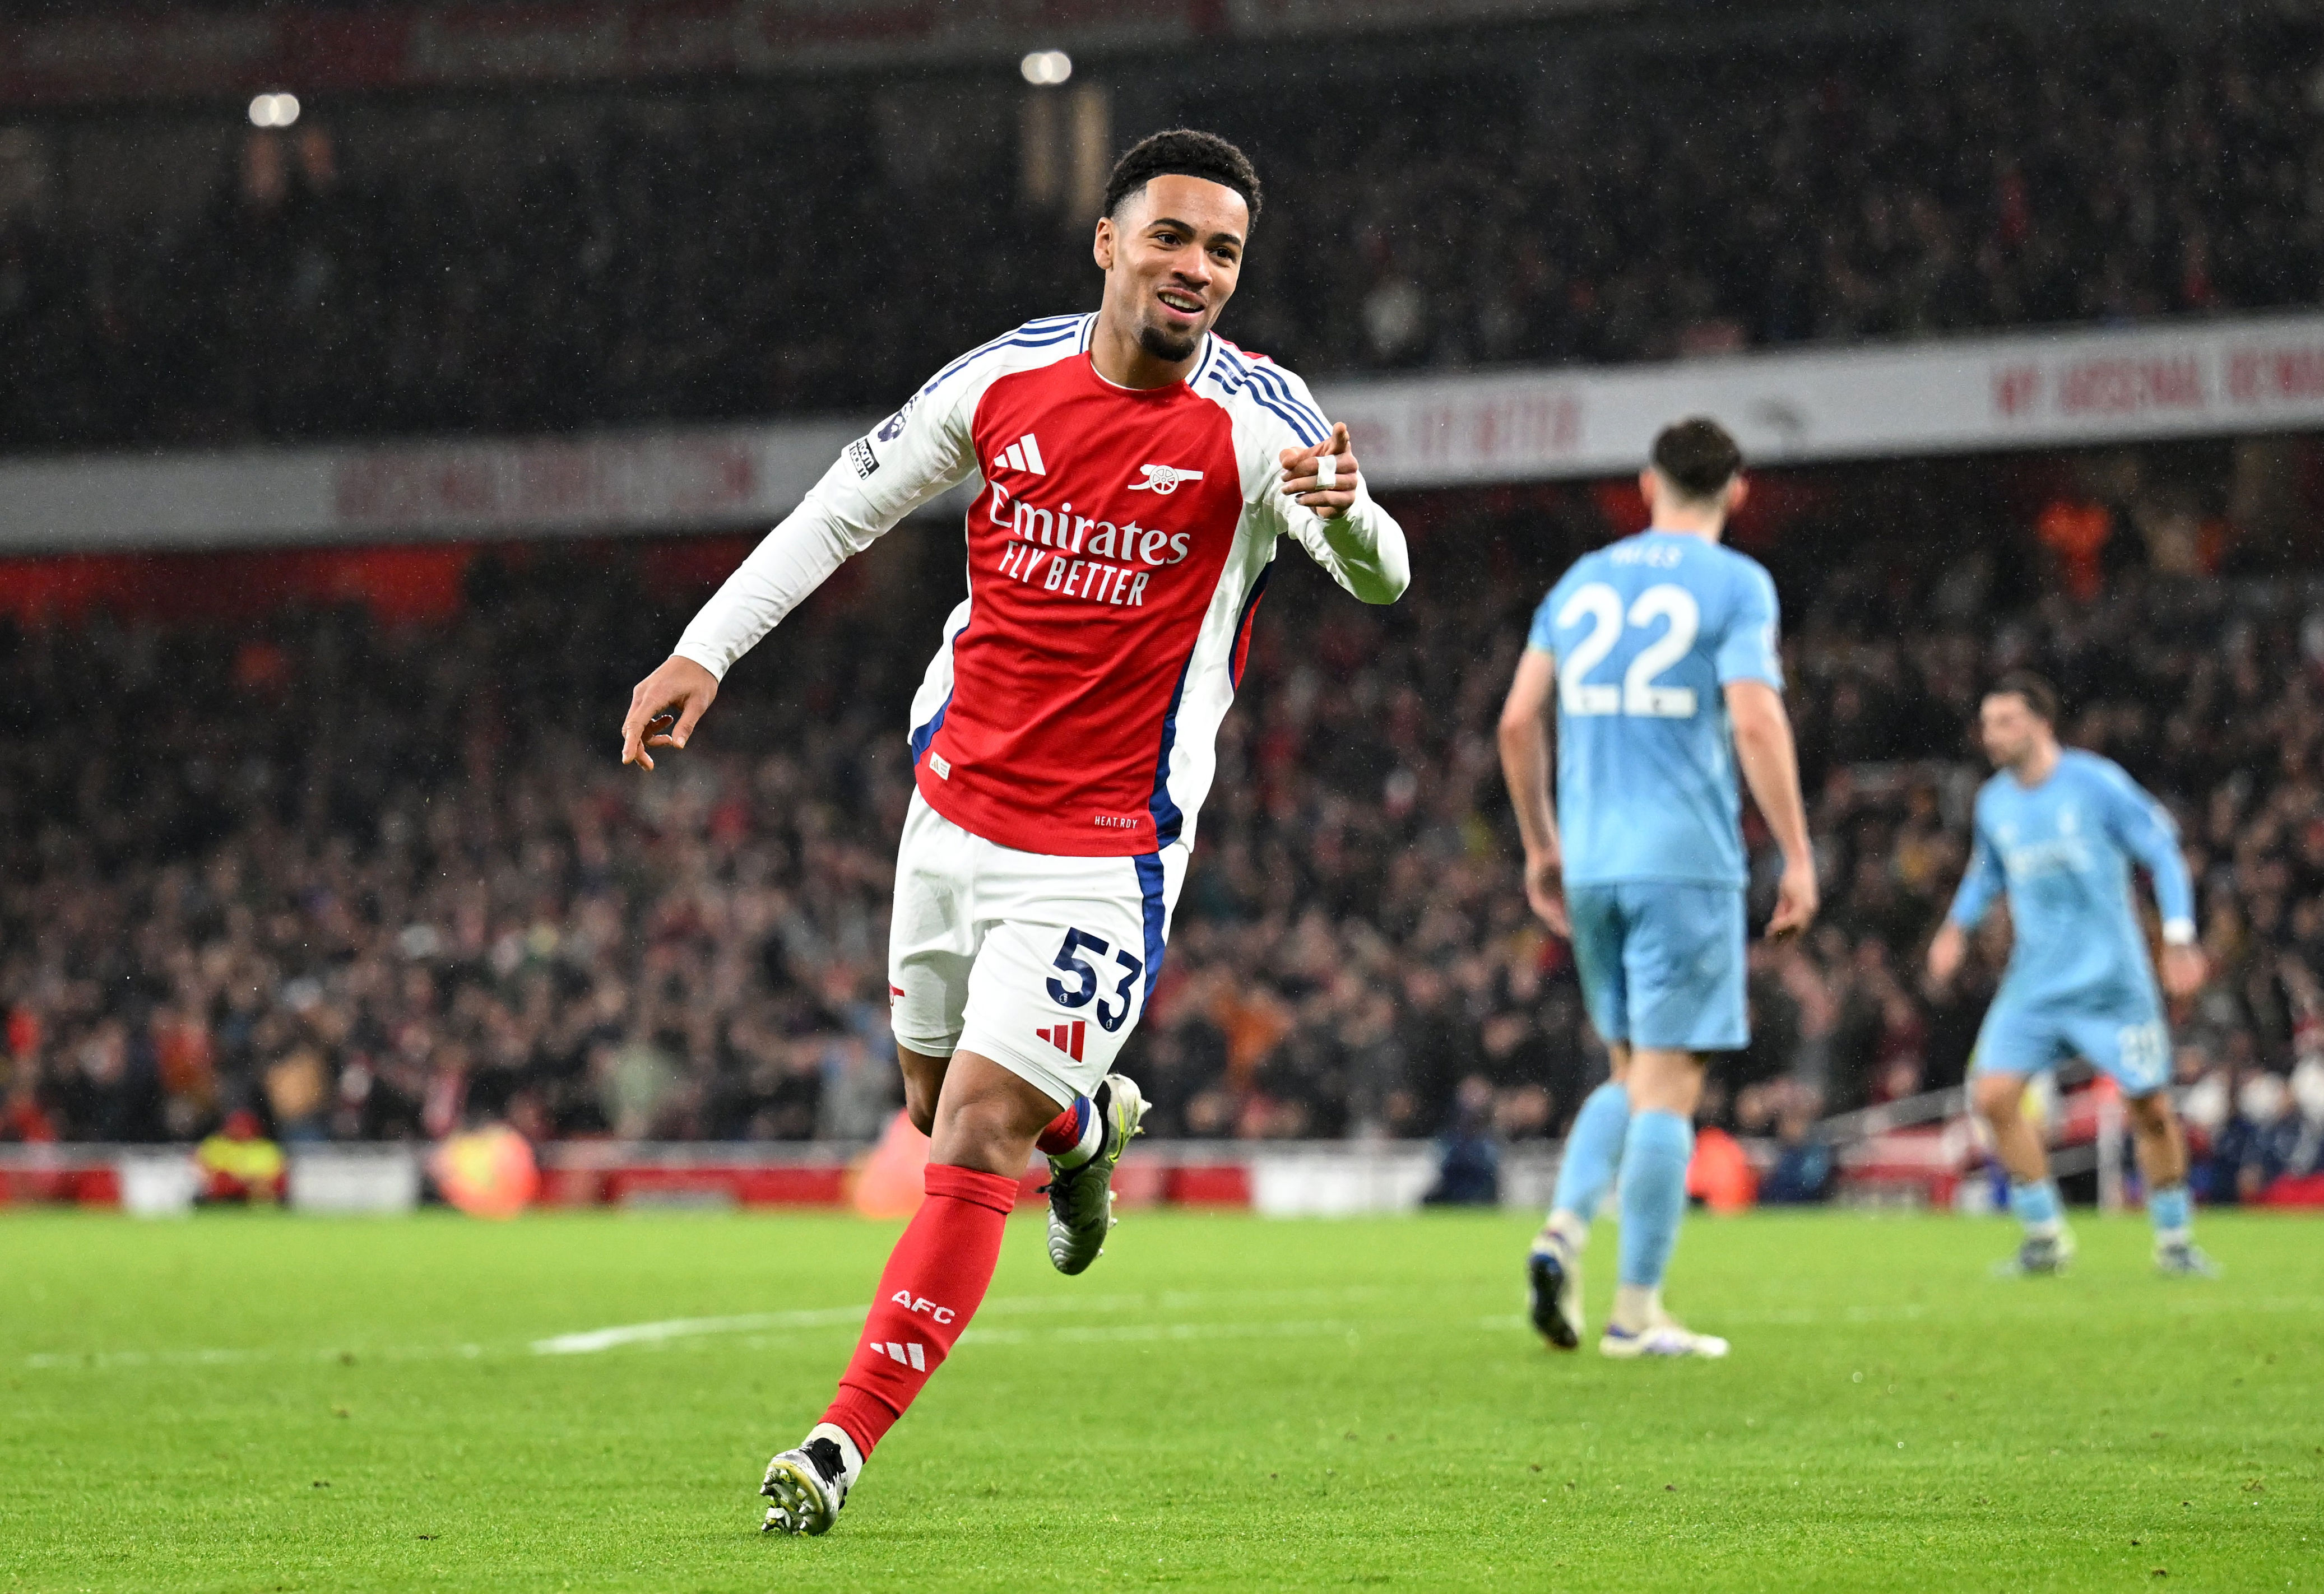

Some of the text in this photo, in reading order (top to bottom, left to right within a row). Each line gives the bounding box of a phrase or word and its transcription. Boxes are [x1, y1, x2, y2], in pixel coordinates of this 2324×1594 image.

[857, 439, 875, 468] room
[989, 480, 1191, 566] Emirates
[998, 540, 1150, 607] FLY BETTER
[1556, 582, 1699, 719] 22
[1094, 815, 1138, 829] HEAT.RDY
[1046, 926, 1143, 1033] 53
[891, 1290, 955, 1325] AFC
